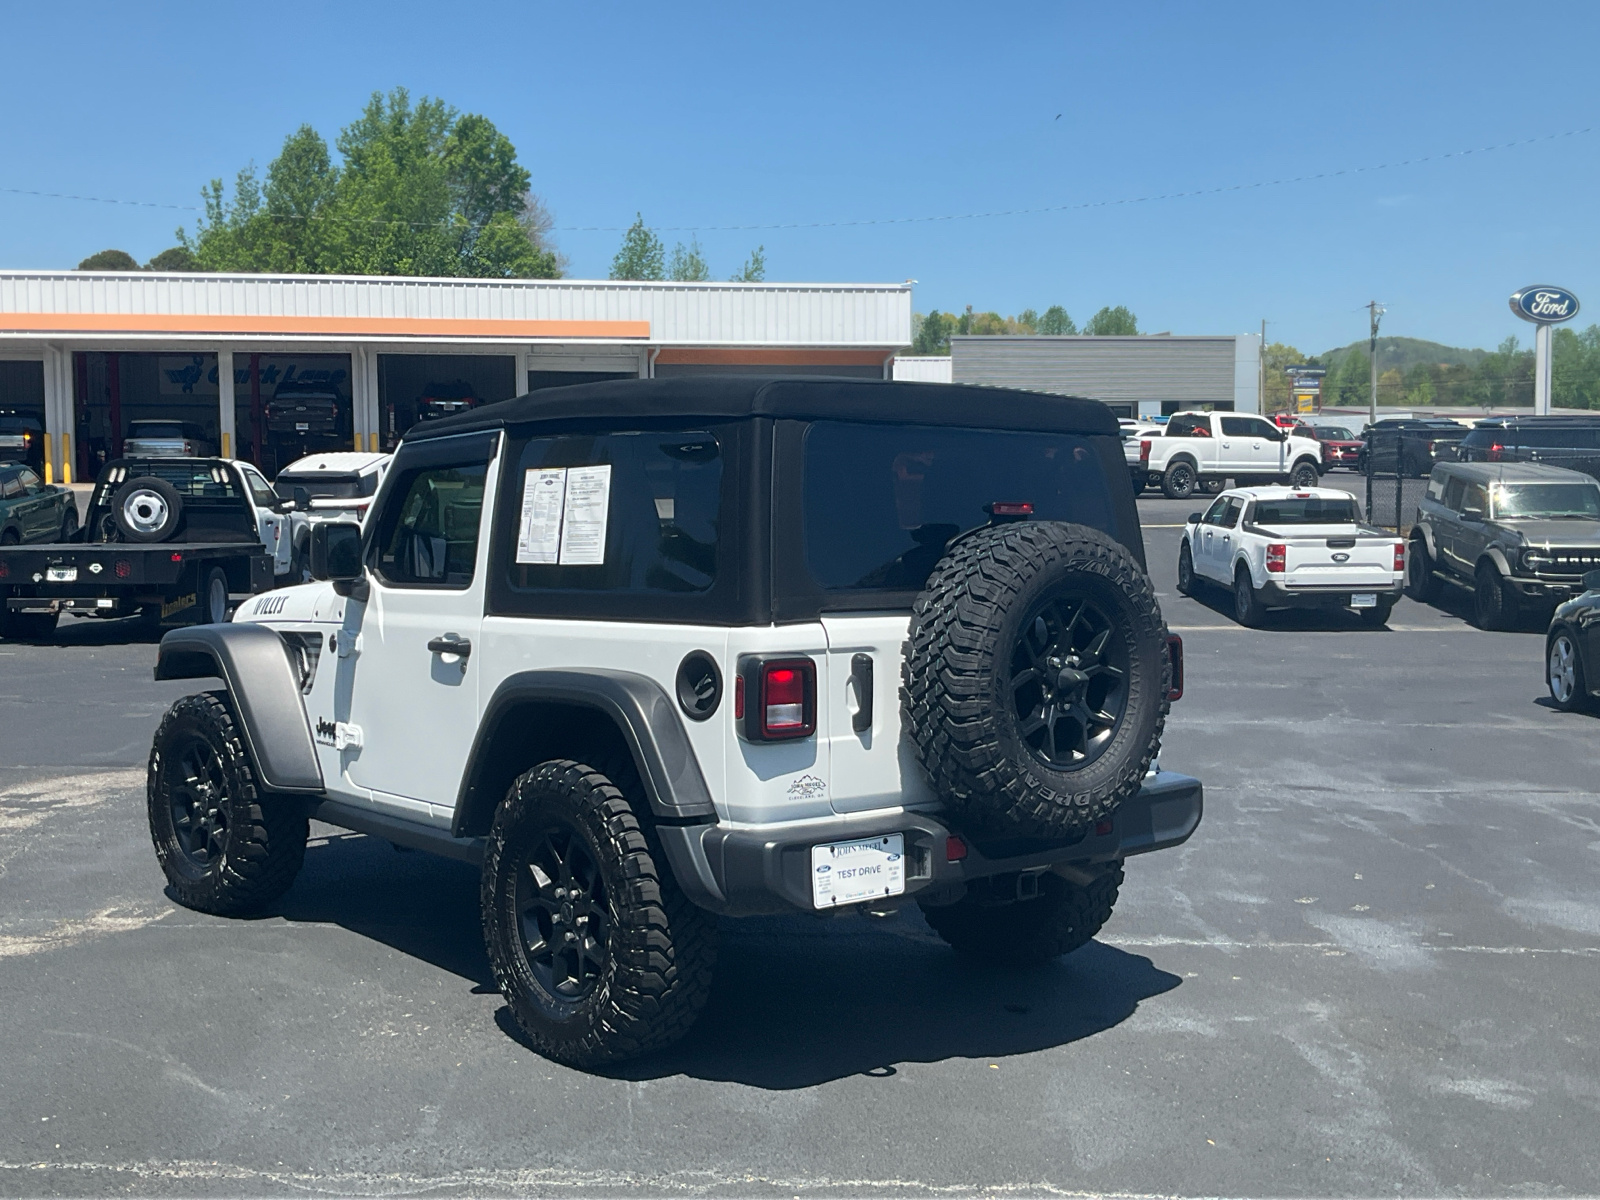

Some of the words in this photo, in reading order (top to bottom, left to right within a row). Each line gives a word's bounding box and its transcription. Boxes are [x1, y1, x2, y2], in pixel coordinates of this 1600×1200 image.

[1531, 291, 1570, 316] Ford
[253, 595, 290, 615] WILLYS
[836, 846, 857, 858] JOHN
[858, 841, 883, 852] MEGEL
[837, 868, 857, 880] TEST
[858, 865, 882, 876] DRIVE
